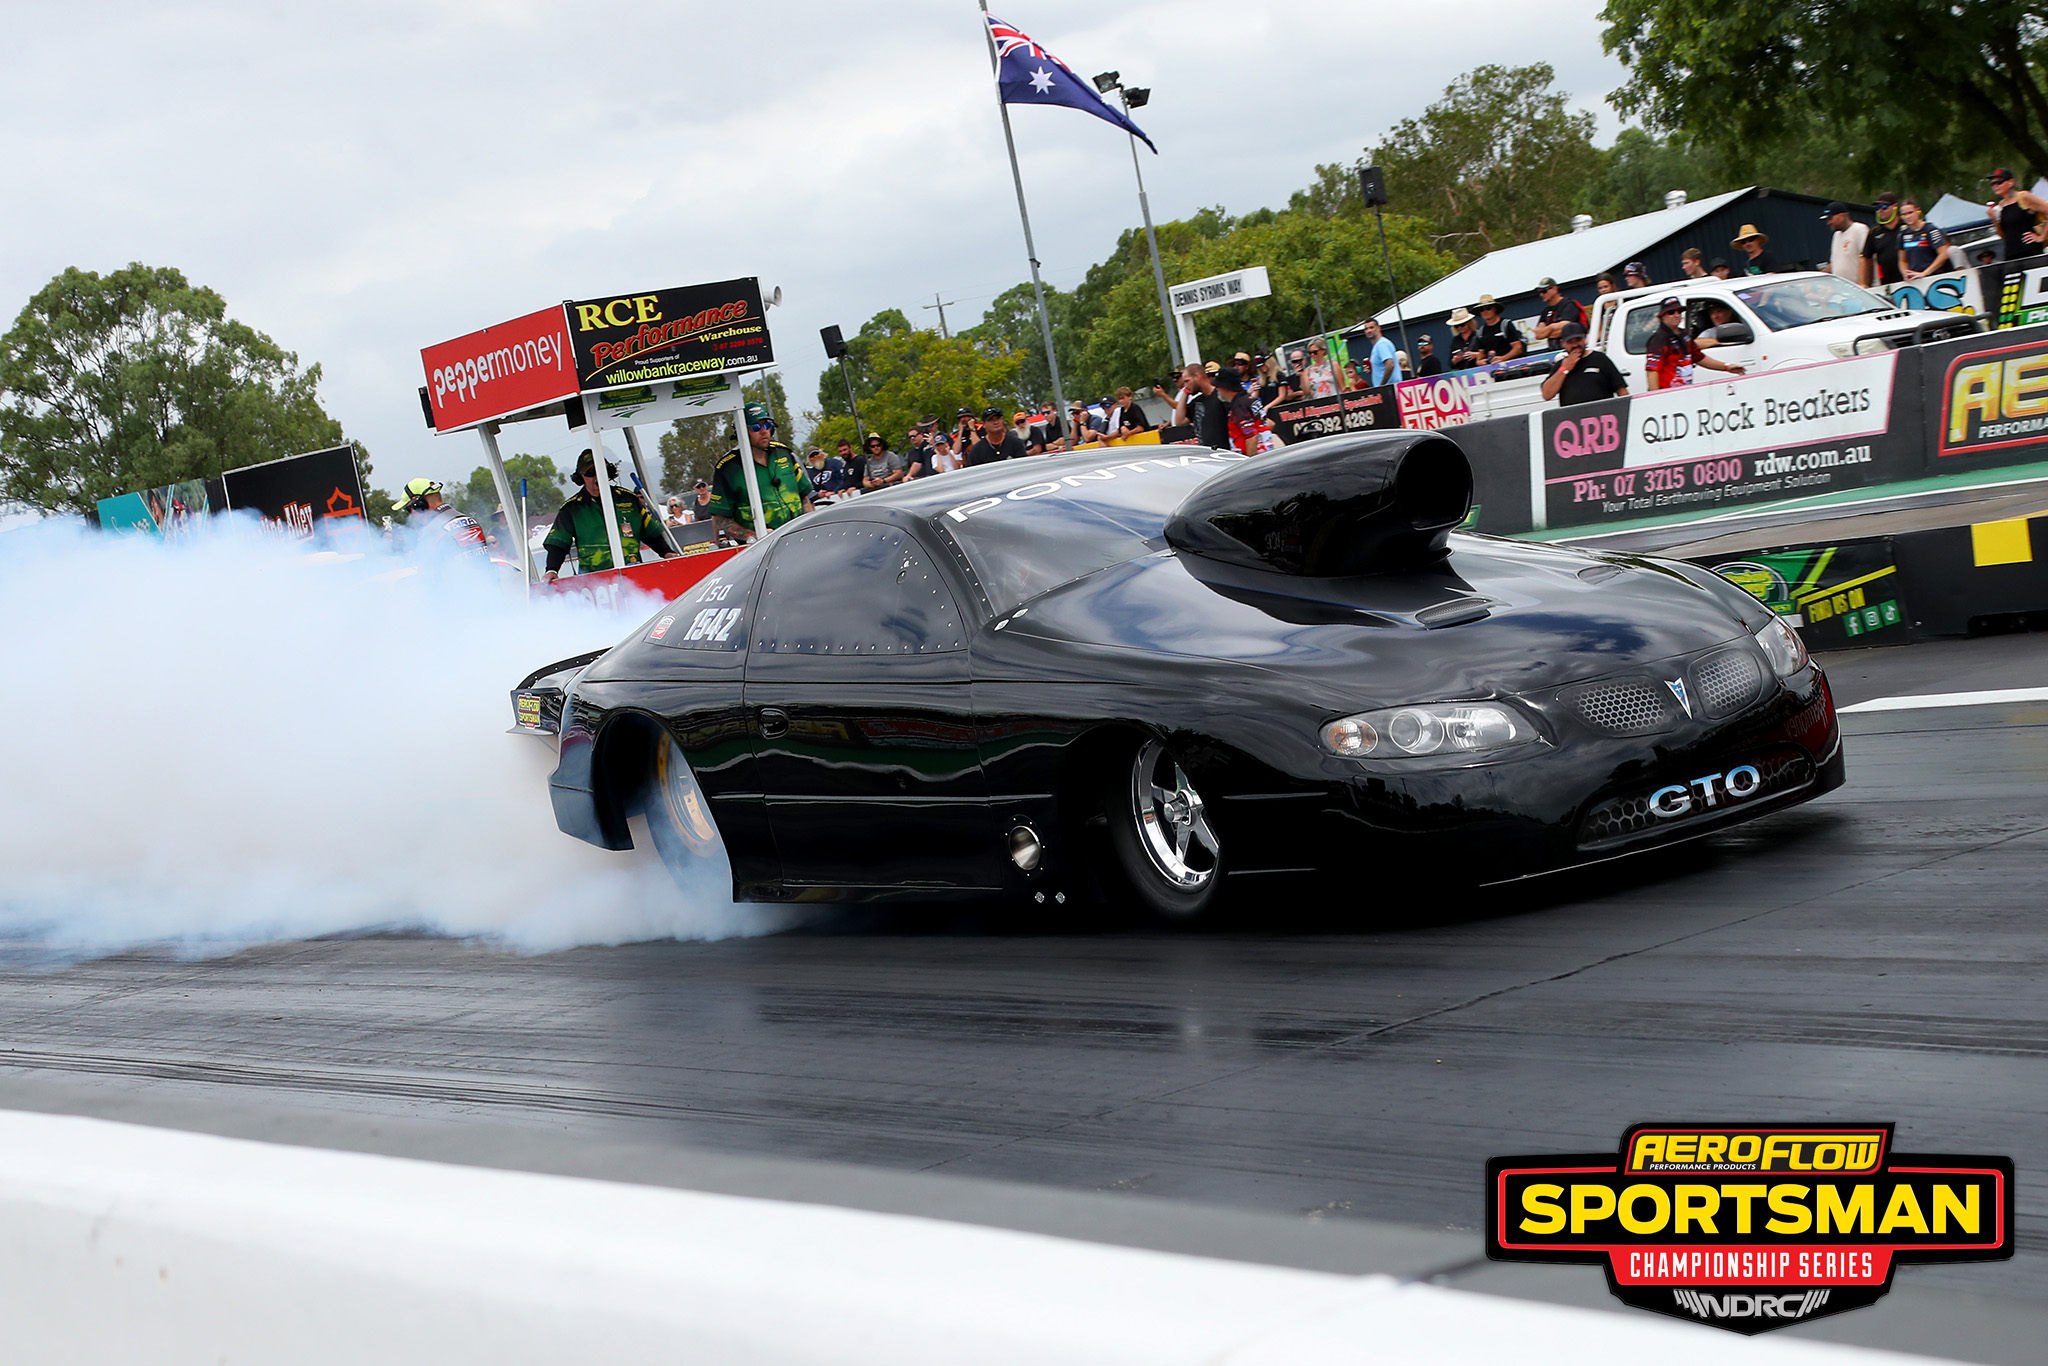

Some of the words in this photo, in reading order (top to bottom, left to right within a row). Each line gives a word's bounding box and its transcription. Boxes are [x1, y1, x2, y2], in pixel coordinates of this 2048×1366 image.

[1174, 289, 1198, 307] DENNIS
[1200, 282, 1226, 301] SYRMIS
[1226, 278, 1242, 295] WAY
[575, 295, 663, 332] RCE
[590, 300, 748, 369] Performance
[699, 326, 762, 343] Warehouse
[433, 331, 562, 409] peppermoney
[606, 354, 758, 385] willowbankraceway.com.au
[649, 355, 674, 363] Supporters
[1305, 403, 1341, 418] Alignmen
[1642, 415, 1688, 444] QLD
[1697, 402, 1754, 437] Rock
[1764, 387, 1870, 426] Breakers
[1553, 414, 1621, 459] QRB
[1754, 445, 1872, 476] rdw.com.au
[946, 451, 1250, 523] PONTIAC
[1573, 480, 1607, 502] Ph:
[1614, 474, 1637, 496] 07
[1643, 467, 1685, 492] 3715
[1693, 458, 1743, 485] 0800
[1602, 501, 1627, 513] Your
[1627, 495, 1654, 510] Total
[1655, 486, 1722, 507] Earthmoving
[1724, 478, 1782, 499] Equipment
[1784, 472, 1831, 489] Solution
[683, 607, 742, 641] 1542
[1808, 599, 1833, 623] FIND
[1832, 594, 1849, 614] US
[1649, 765, 1760, 818] GTO
